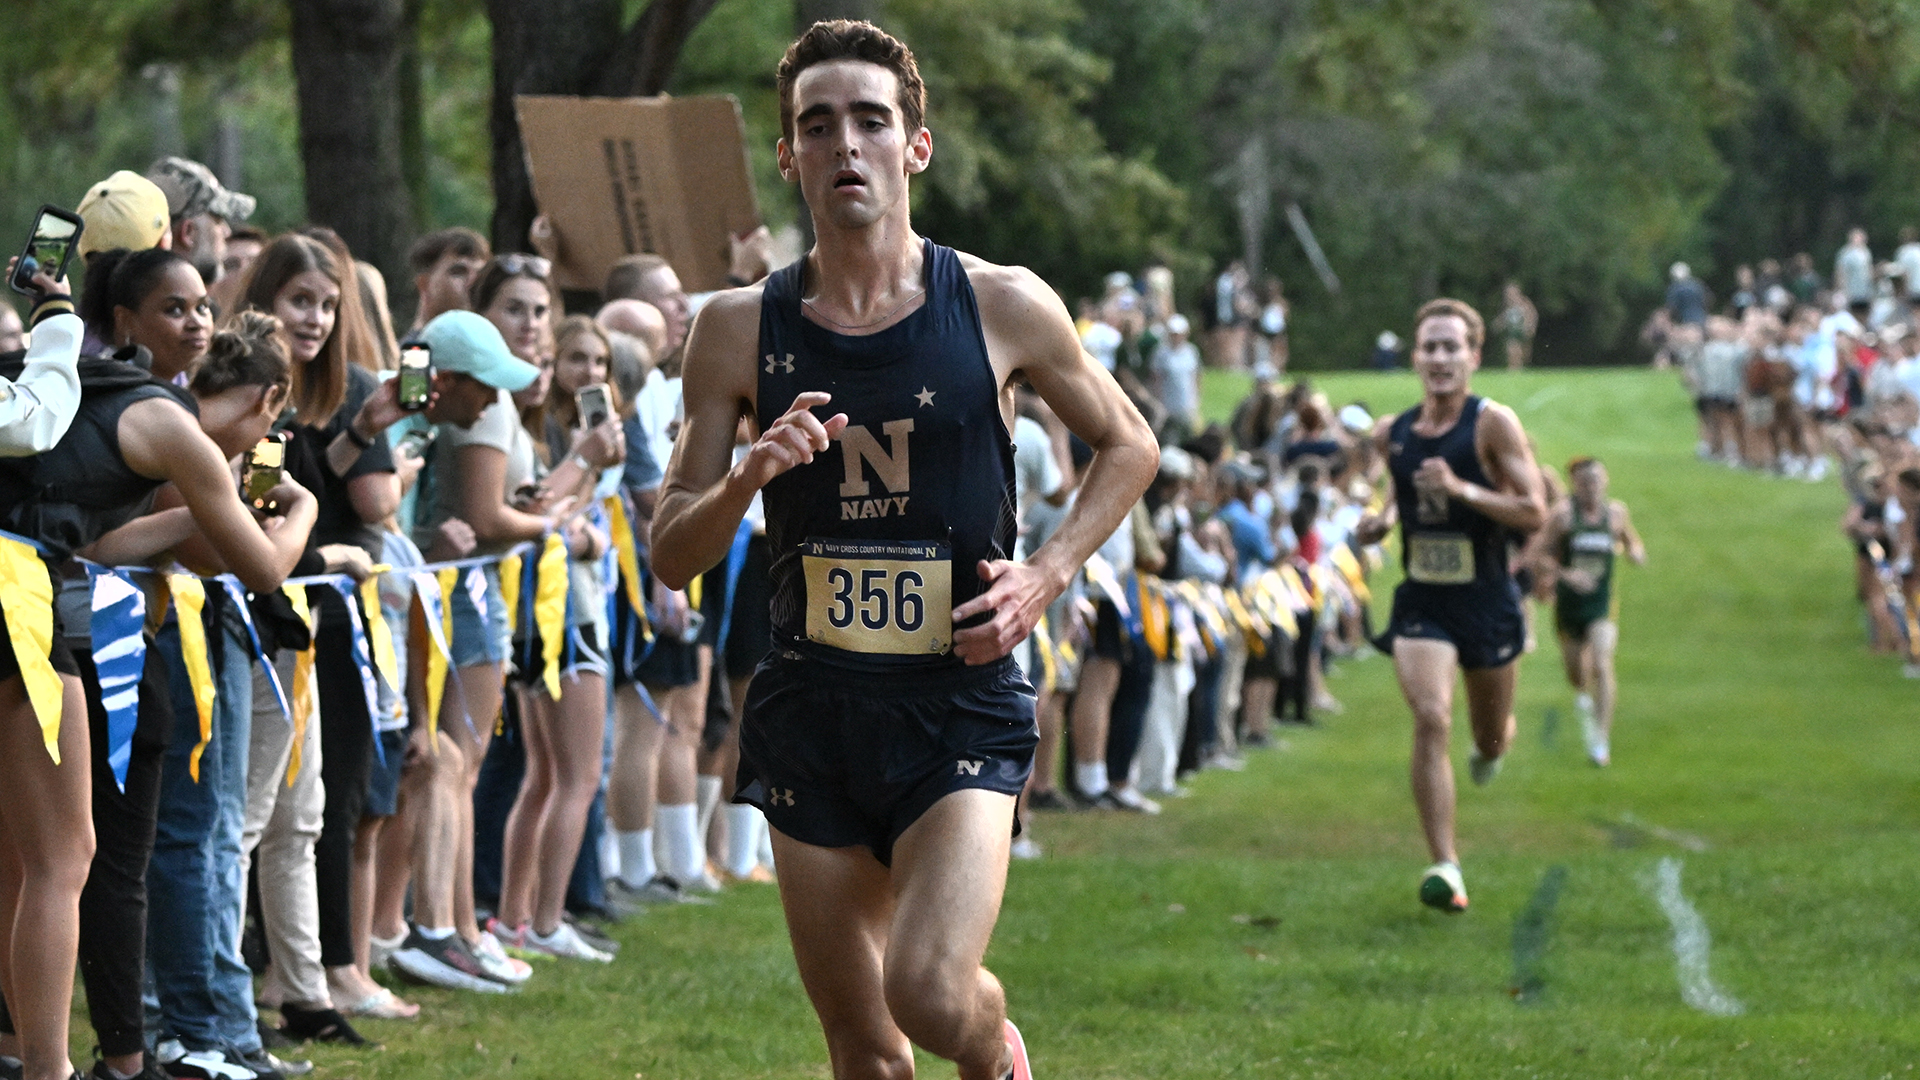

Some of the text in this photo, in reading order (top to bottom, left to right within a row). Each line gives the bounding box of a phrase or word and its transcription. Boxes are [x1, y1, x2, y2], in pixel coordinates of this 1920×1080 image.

[835, 418, 914, 497] N
[840, 496, 910, 520] NAVY
[812, 543, 937, 558] N NAVY CROSS COUNTRY INVITATIONAL N
[827, 567, 925, 633] 356
[955, 760, 984, 776] N
